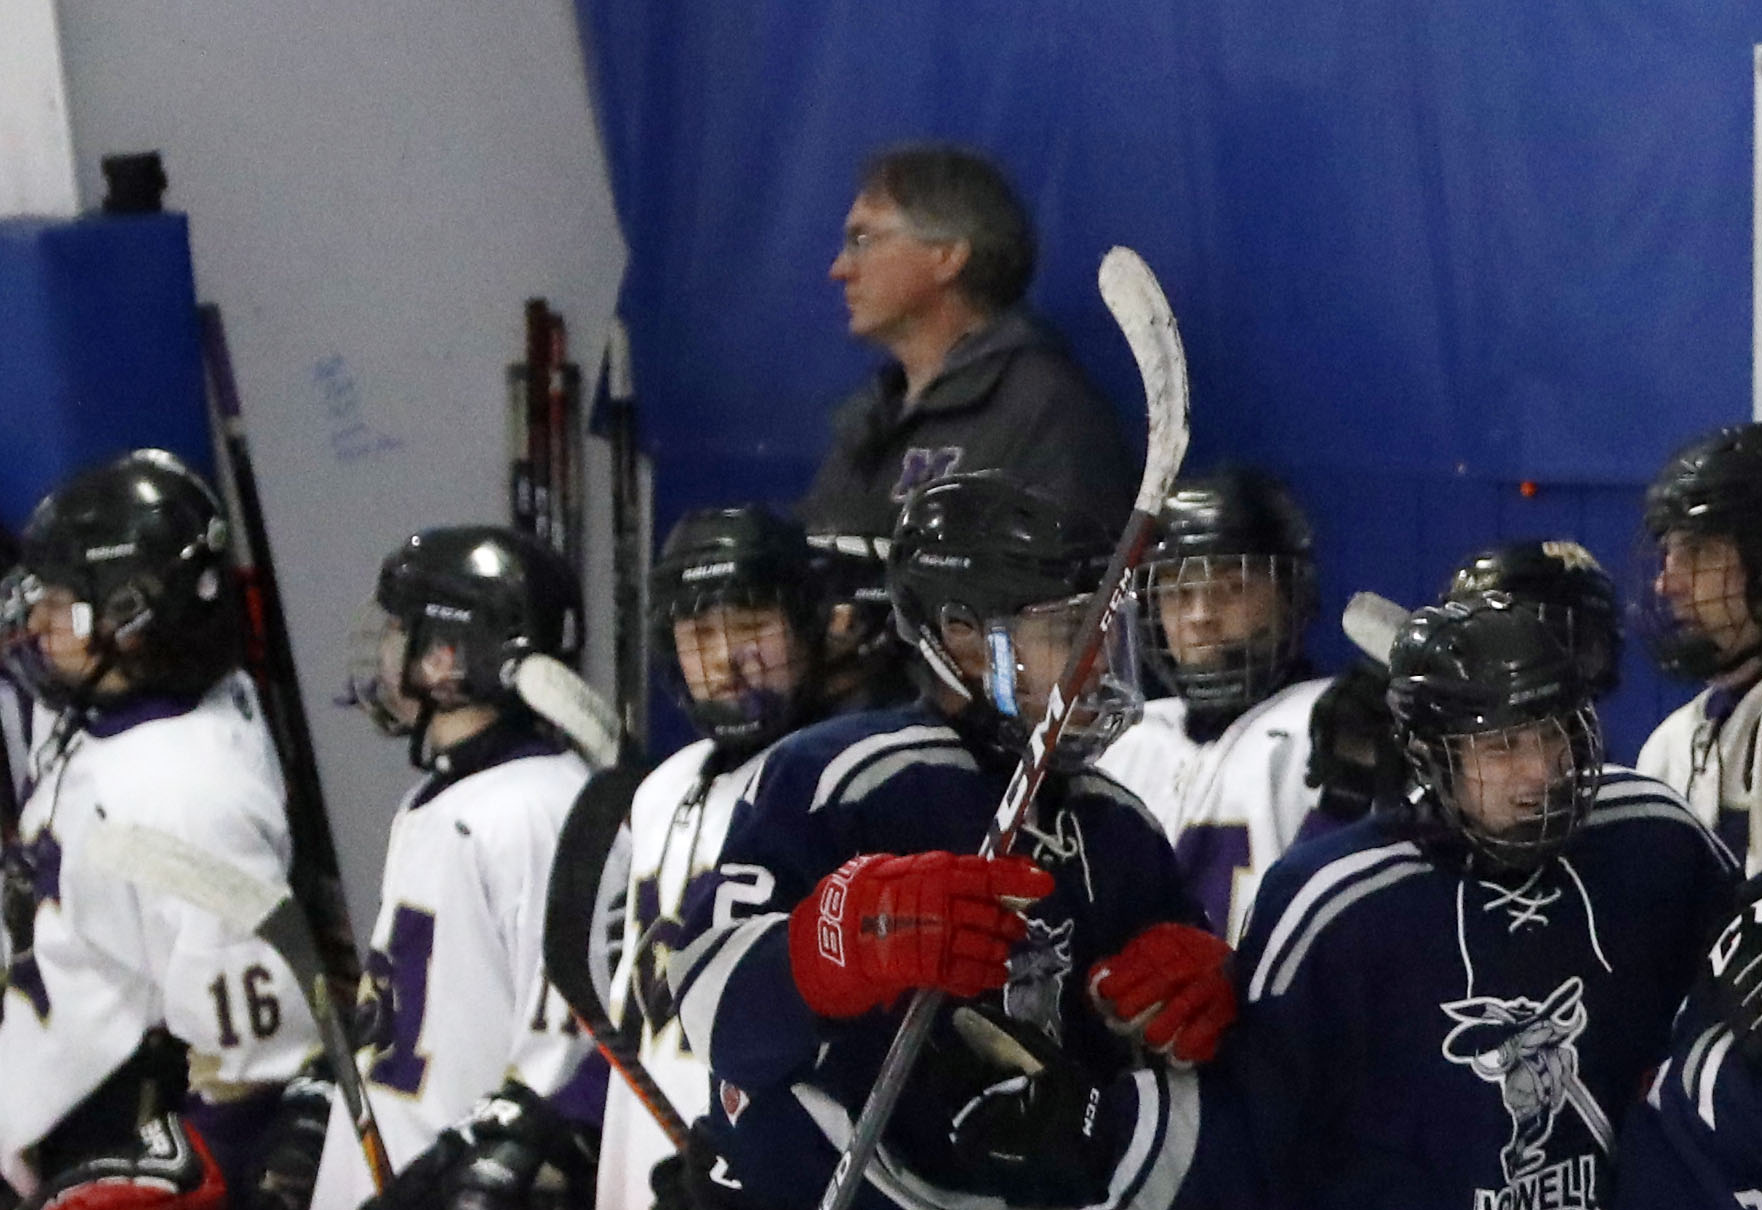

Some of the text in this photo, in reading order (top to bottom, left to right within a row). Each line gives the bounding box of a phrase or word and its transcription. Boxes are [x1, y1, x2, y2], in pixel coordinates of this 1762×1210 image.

[817, 855, 872, 968] BAU
[208, 964, 280, 1048] 16
[1082, 1087, 1100, 1138] CCM
